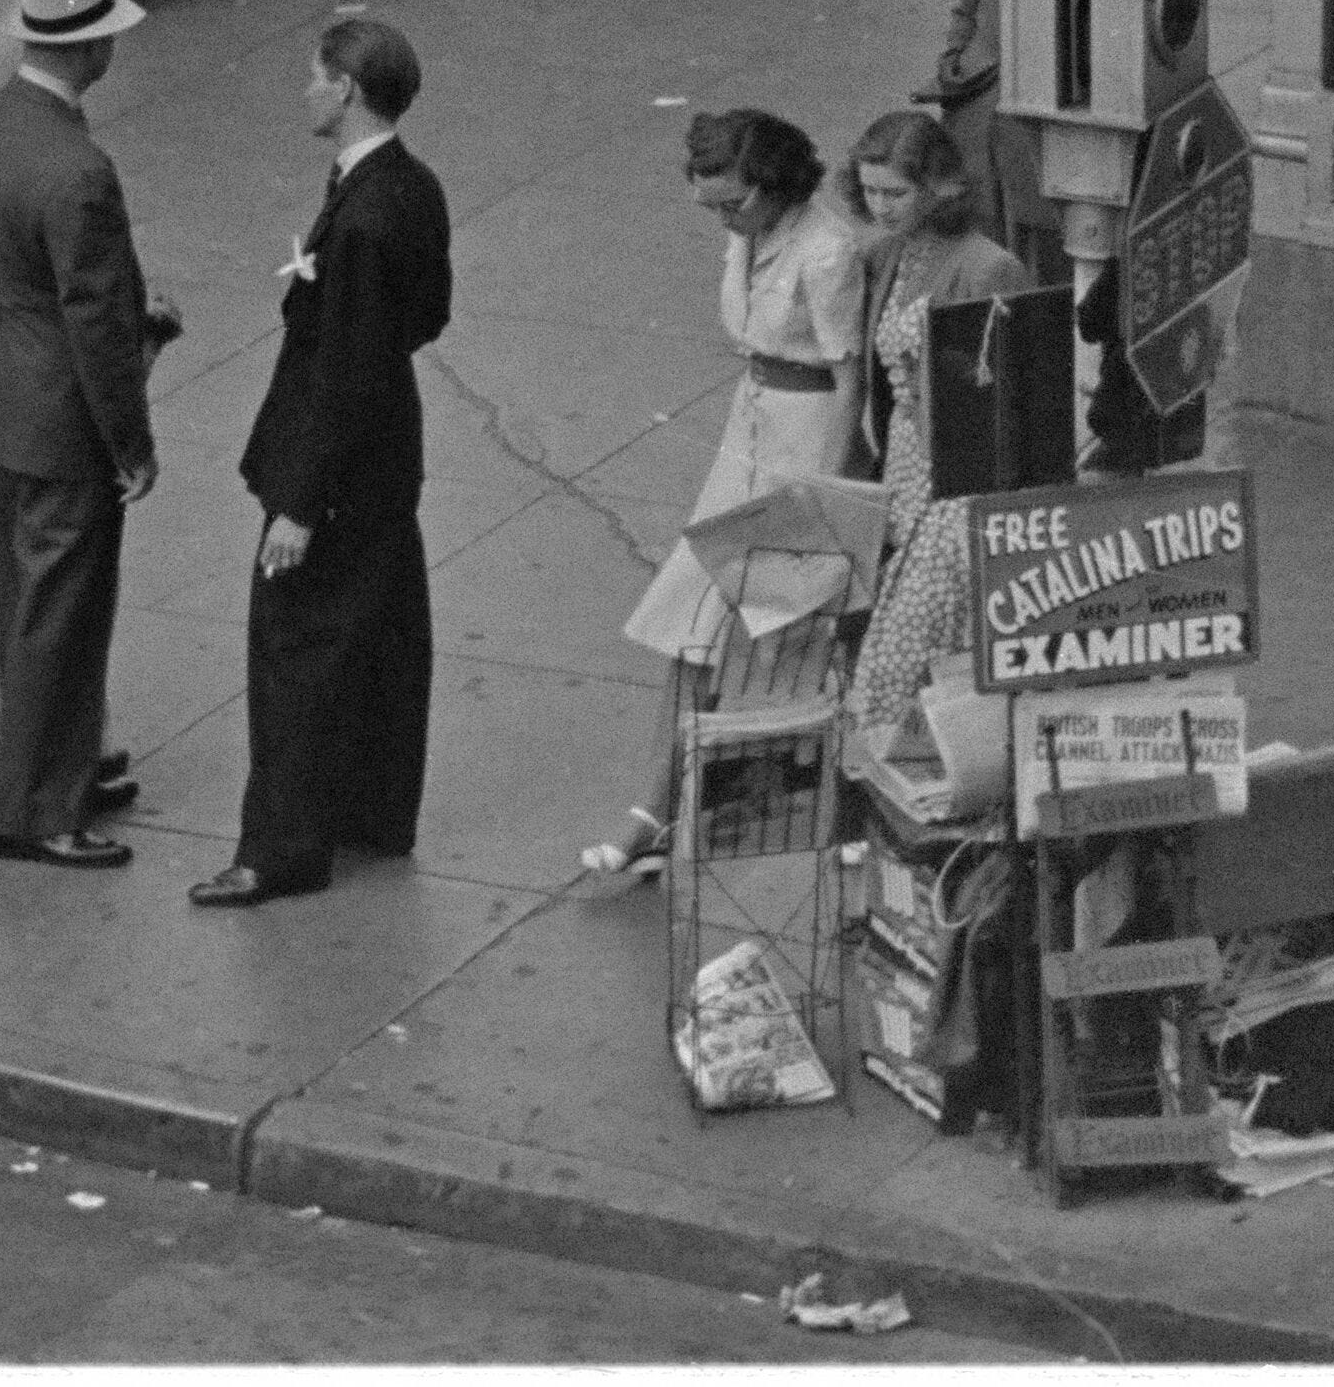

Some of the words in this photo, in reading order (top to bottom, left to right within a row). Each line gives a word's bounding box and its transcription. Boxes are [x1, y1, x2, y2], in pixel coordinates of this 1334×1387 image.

[985, 506, 1069, 556] FREE
[987, 529, 1147, 634] CATALINA
[1144, 501, 1244, 567] TRIPS
[1077, 601, 1120, 621] MEN
[1147, 590, 1227, 614] WOMEN
[992, 613, 1244, 680] EXAMINER
